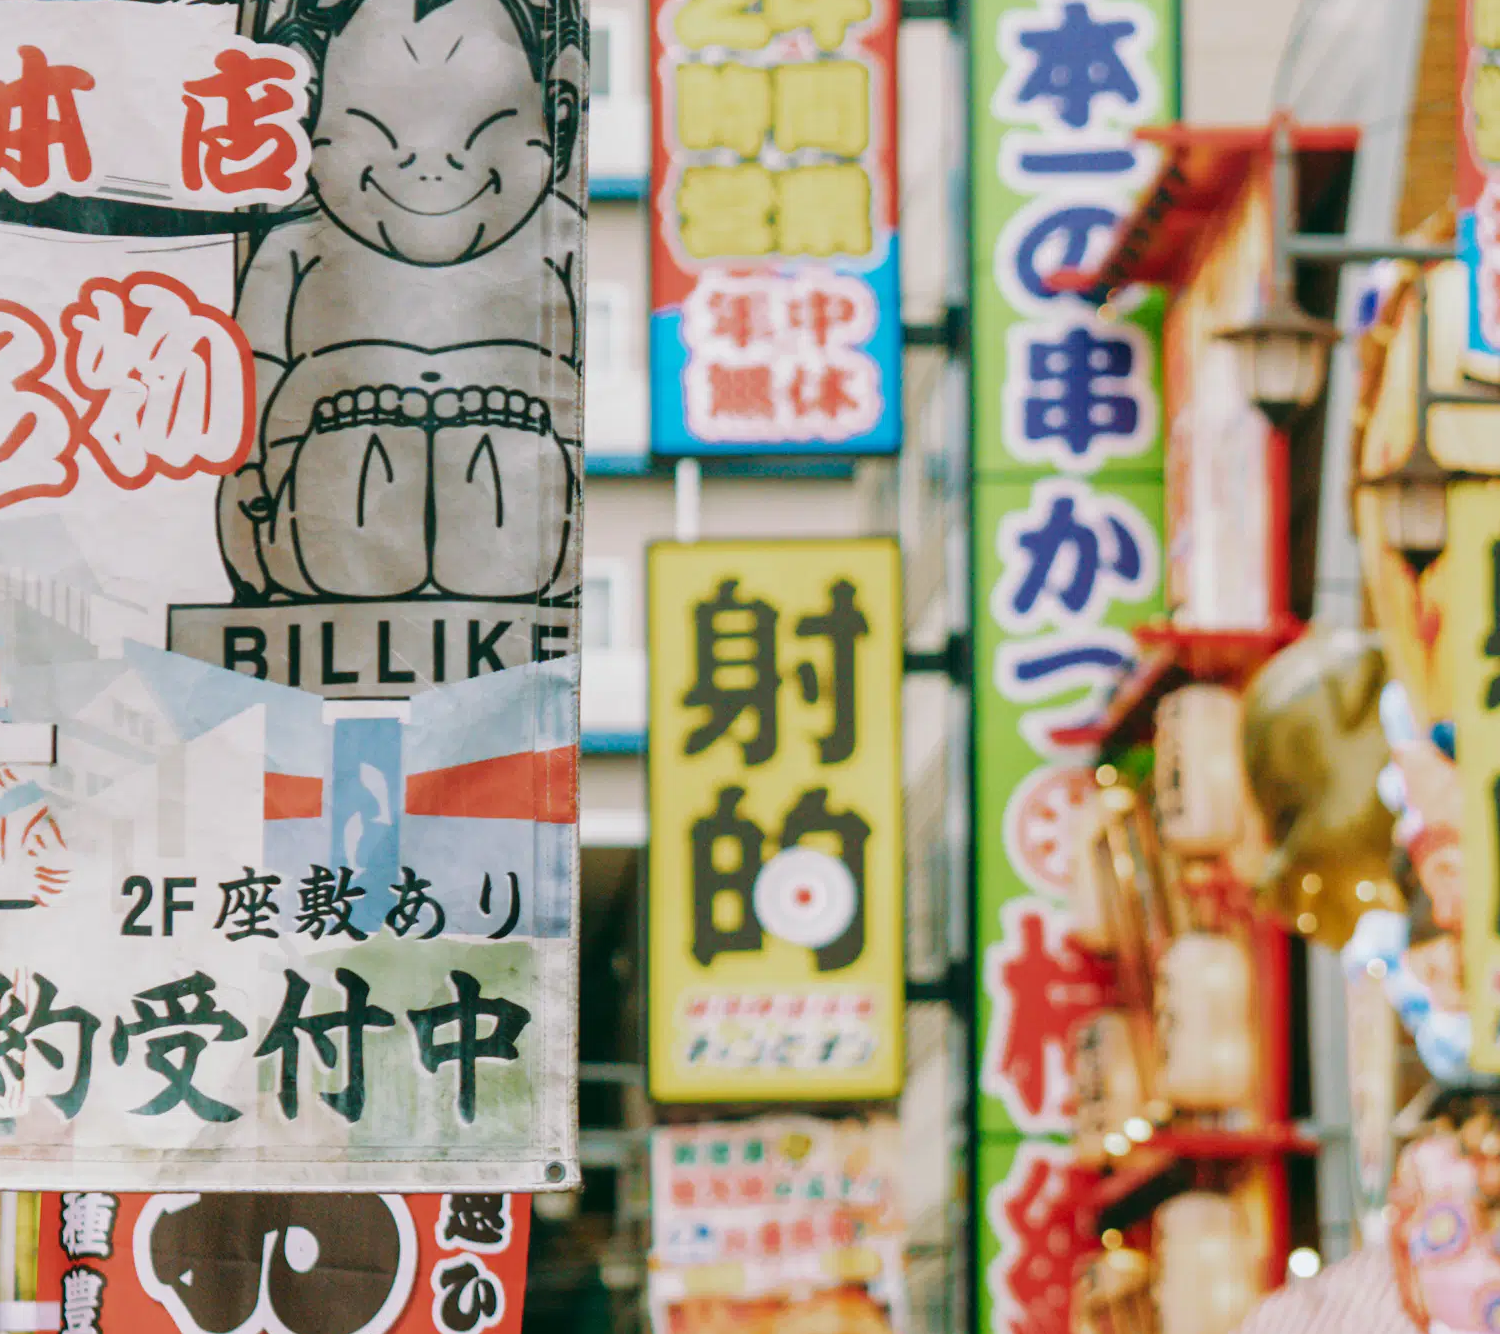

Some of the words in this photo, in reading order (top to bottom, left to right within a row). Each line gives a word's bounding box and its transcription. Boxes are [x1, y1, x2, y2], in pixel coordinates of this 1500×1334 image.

[706, 288, 856, 352] 年中
[708, 364, 860, 422] 無休
[681, 575, 873, 973] 射的
[119, 873, 198, 940] 2F
[213, 864, 524, 944] 座敷あり
